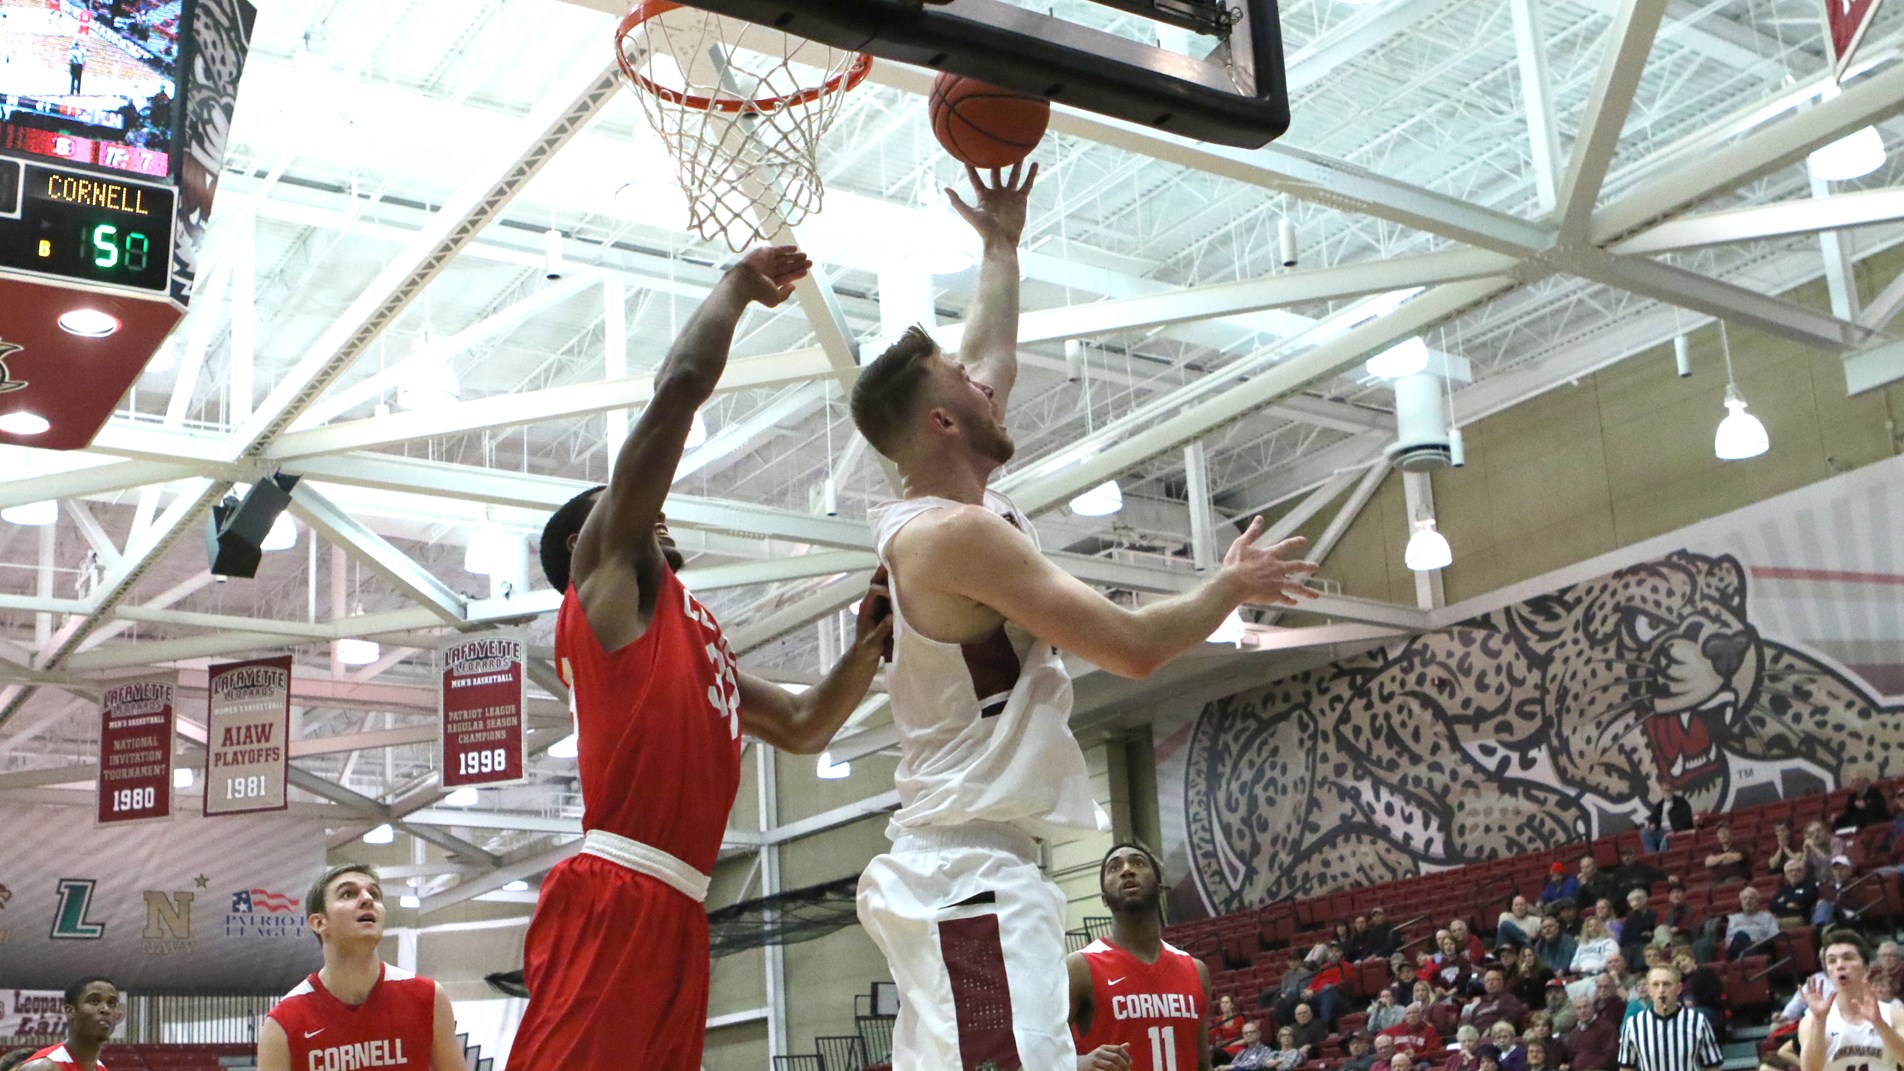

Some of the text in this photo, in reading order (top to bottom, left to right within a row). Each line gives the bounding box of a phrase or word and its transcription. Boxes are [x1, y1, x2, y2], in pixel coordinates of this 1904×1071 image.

[48, 174, 149, 215] CORNELL
[38, 239, 51, 257] B
[443, 640, 521, 668] LAFAYETTE
[455, 657, 509, 673] LEOPARDS
[214, 668, 285, 696] LAFAYETTE
[451, 673, 513, 688] MEN'S BASKETBALL
[103, 683, 172, 709] LAFAYETTE
[224, 686, 275, 700] LEOPARDS
[108, 715, 165, 730] MEN'S BASKETBALL
[448, 704, 517, 722] PATRIOT LEAGUE
[221, 723, 274, 748] AIAW
[447, 716, 518, 734] REGULAR SEASON
[113, 736, 159, 751] NATIONAL
[458, 730, 507, 745] CHAMPIONS
[109, 750, 163, 766] INVITATION
[214, 747, 280, 768] PLAYOFFS
[459, 748, 506, 775] 1998
[102, 764, 167, 781] TOURNAMENT
[1738, 767, 1754, 779] TM
[226, 775, 266, 800] 1981
[112, 786, 155, 812] 1980
[50, 878, 105, 939] L
[142, 890, 195, 939] N
[225, 915, 305, 927] PATRIOT
[1112, 993, 1199, 1020] CORNELL
[308, 1038, 408, 1071] CORNELL
[1147, 1025, 1177, 1071] 11
